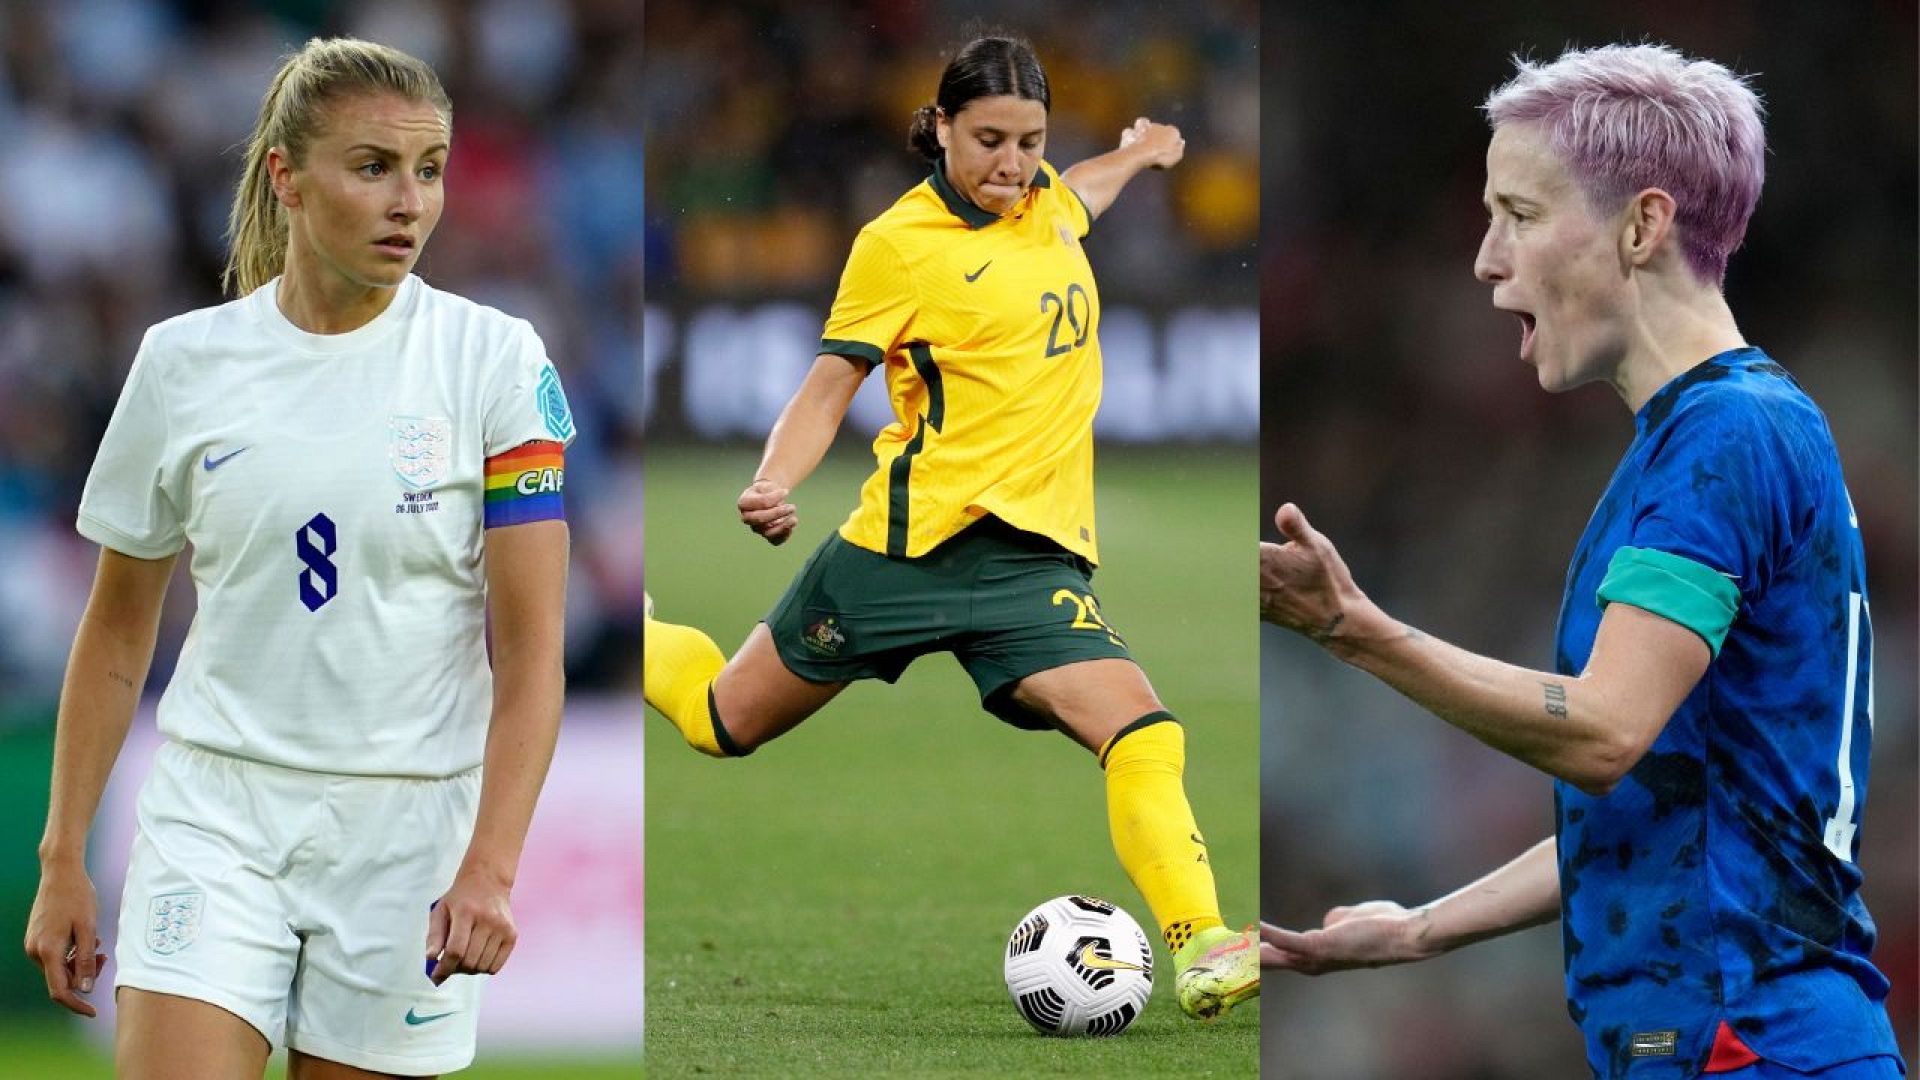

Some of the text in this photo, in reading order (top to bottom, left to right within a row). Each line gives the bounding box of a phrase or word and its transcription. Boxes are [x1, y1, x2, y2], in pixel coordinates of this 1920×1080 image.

[1040, 283, 1090, 358] 20
[403, 491, 432, 502] SWEDEN
[406, 503, 424, 513] JULY
[296, 512, 337, 612] 8
